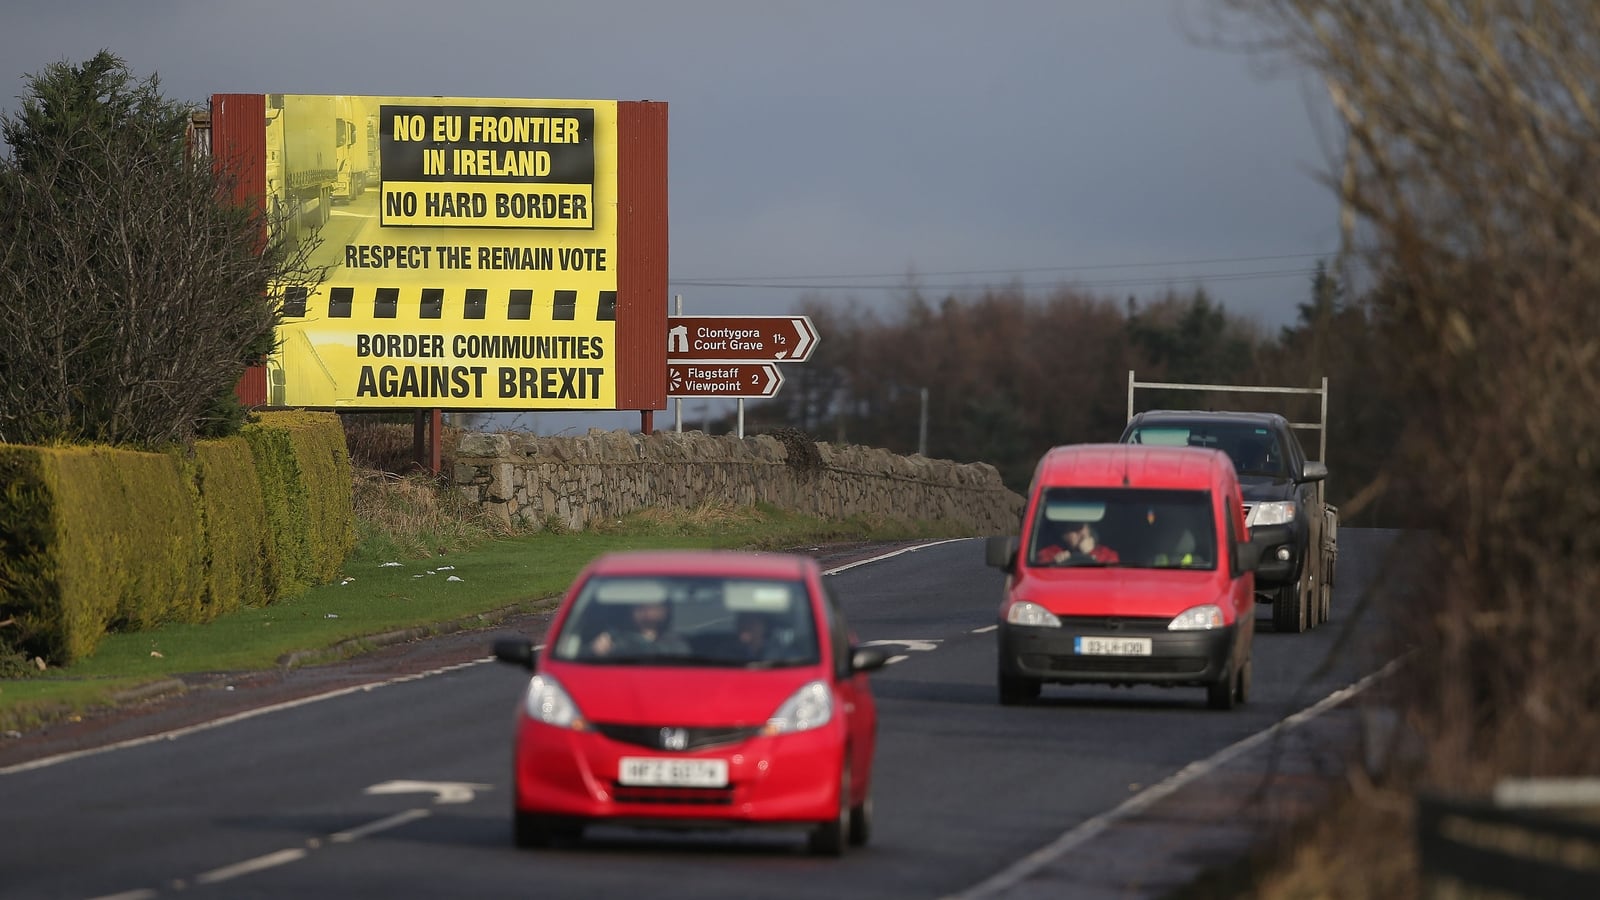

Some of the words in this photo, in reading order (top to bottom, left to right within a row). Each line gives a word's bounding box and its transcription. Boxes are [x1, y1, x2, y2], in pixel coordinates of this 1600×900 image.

[394, 115, 425, 141] NO
[434, 116, 461, 141] EU
[470, 117, 579, 143] FRONTIER
[424, 150, 445, 175] IN
[454, 150, 550, 176] IRELAND
[387, 192, 417, 217] NO
[426, 193, 487, 217] HARD
[496, 193, 587, 219] BORDER
[346, 245, 431, 268] RESPECT
[436, 247, 471, 269] THE
[478, 247, 553, 270] REMAIN
[558, 248, 606, 271] VOTE
[694, 340, 727, 350] Court
[729, 340, 764, 350] Grave
[697, 327, 760, 340] Clontygora
[357, 334, 445, 357] BORDER
[453, 335, 603, 359] COMMUNITIES
[357, 365, 487, 398] AGAINST
[499, 367, 604, 399] BREXIT
[685, 380, 742, 393] Viewpoint
[688, 368, 739, 380] Flagstaff
[751, 375, 759, 385] 2
